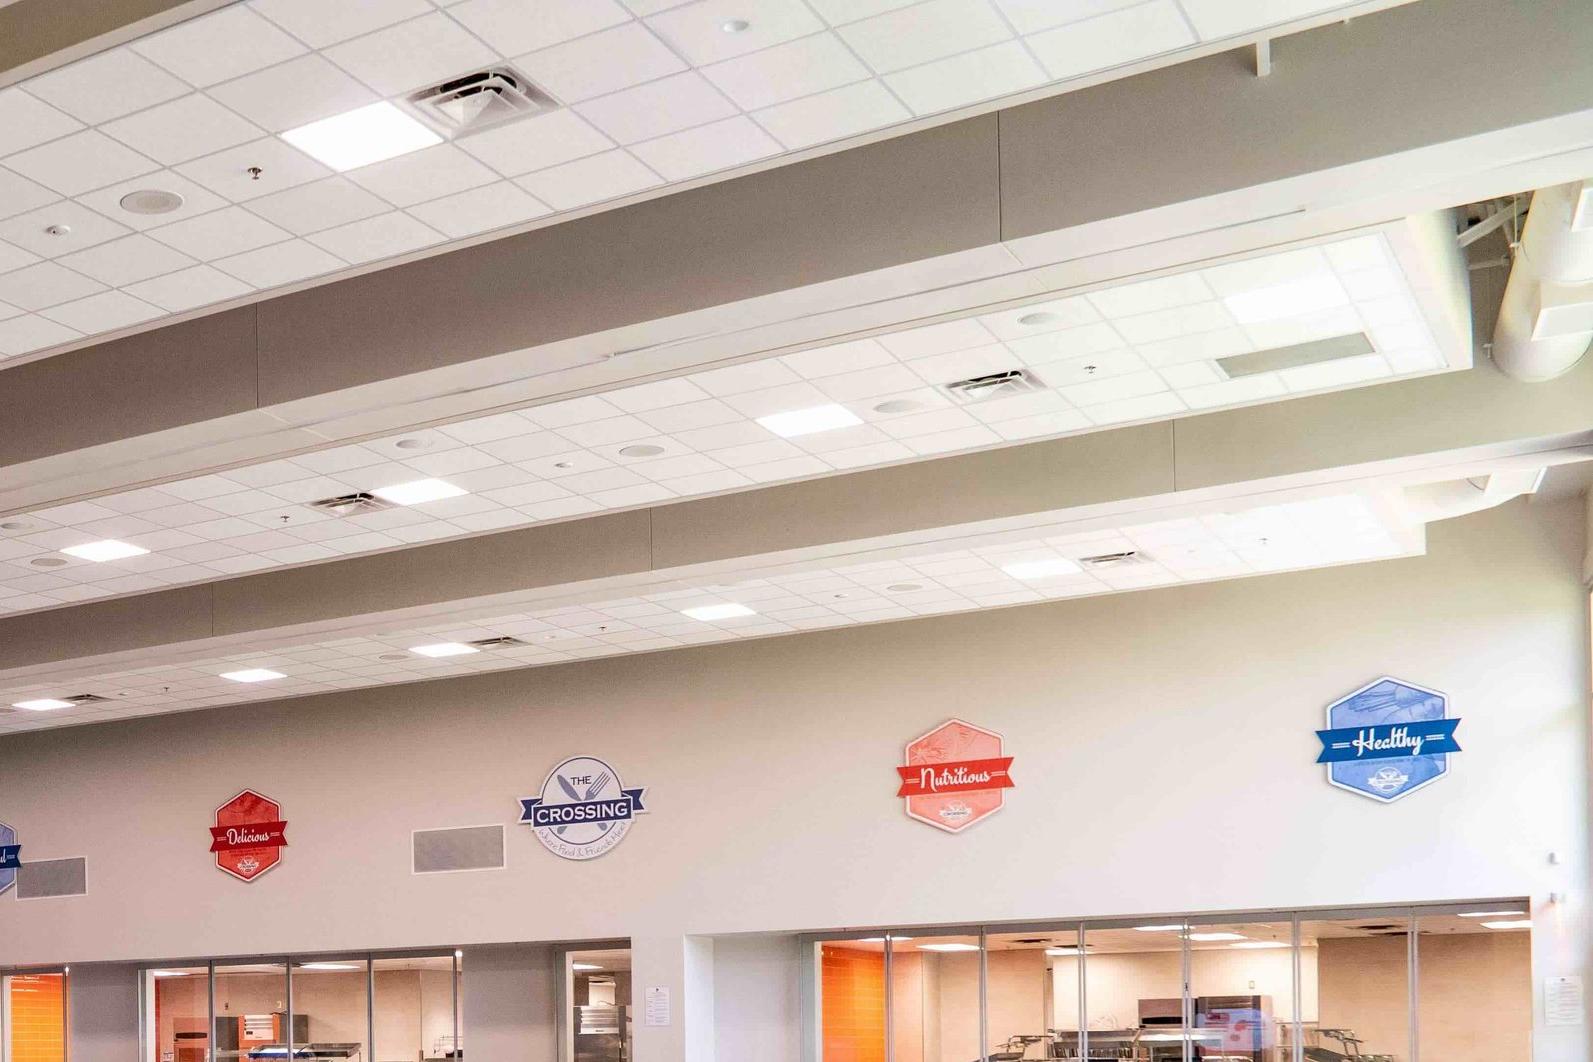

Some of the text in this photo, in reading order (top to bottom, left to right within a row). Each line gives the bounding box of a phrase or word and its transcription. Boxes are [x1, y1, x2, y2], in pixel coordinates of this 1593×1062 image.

[1351, 726, 1424, 756] Healthy
[570, 775, 592, 786] THE
[920, 766, 991, 792] Nutritious
[536, 802, 628, 823] CROSSING
[226, 827, 270, 846] Delicious
